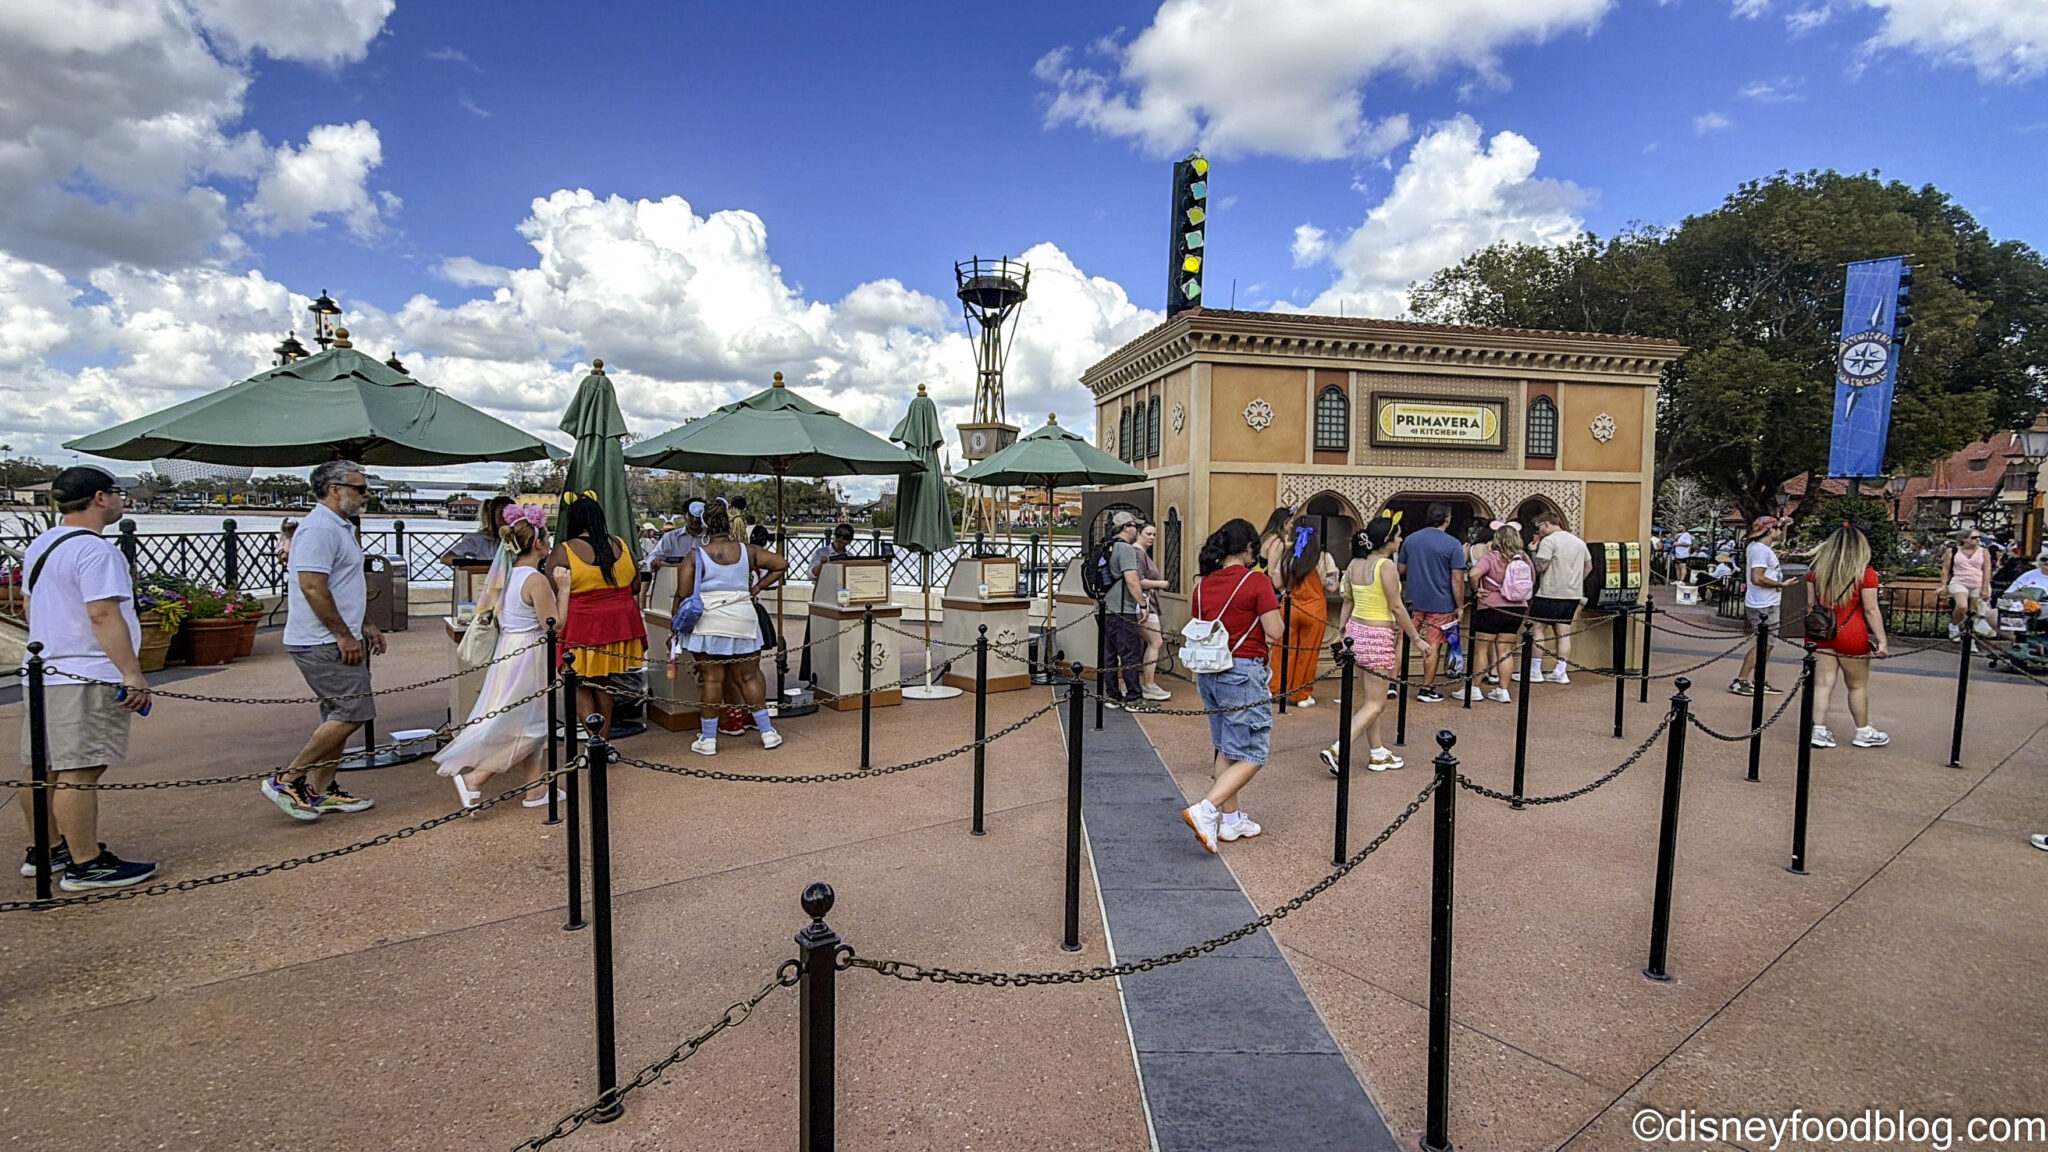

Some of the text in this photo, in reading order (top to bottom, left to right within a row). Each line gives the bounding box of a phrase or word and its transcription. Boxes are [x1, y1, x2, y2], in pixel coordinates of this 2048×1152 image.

[1397, 415, 1480, 428] PRIMAVERA
[1420, 428, 1458, 436] KITCHEN
[976, 436, 981, 446] 8
